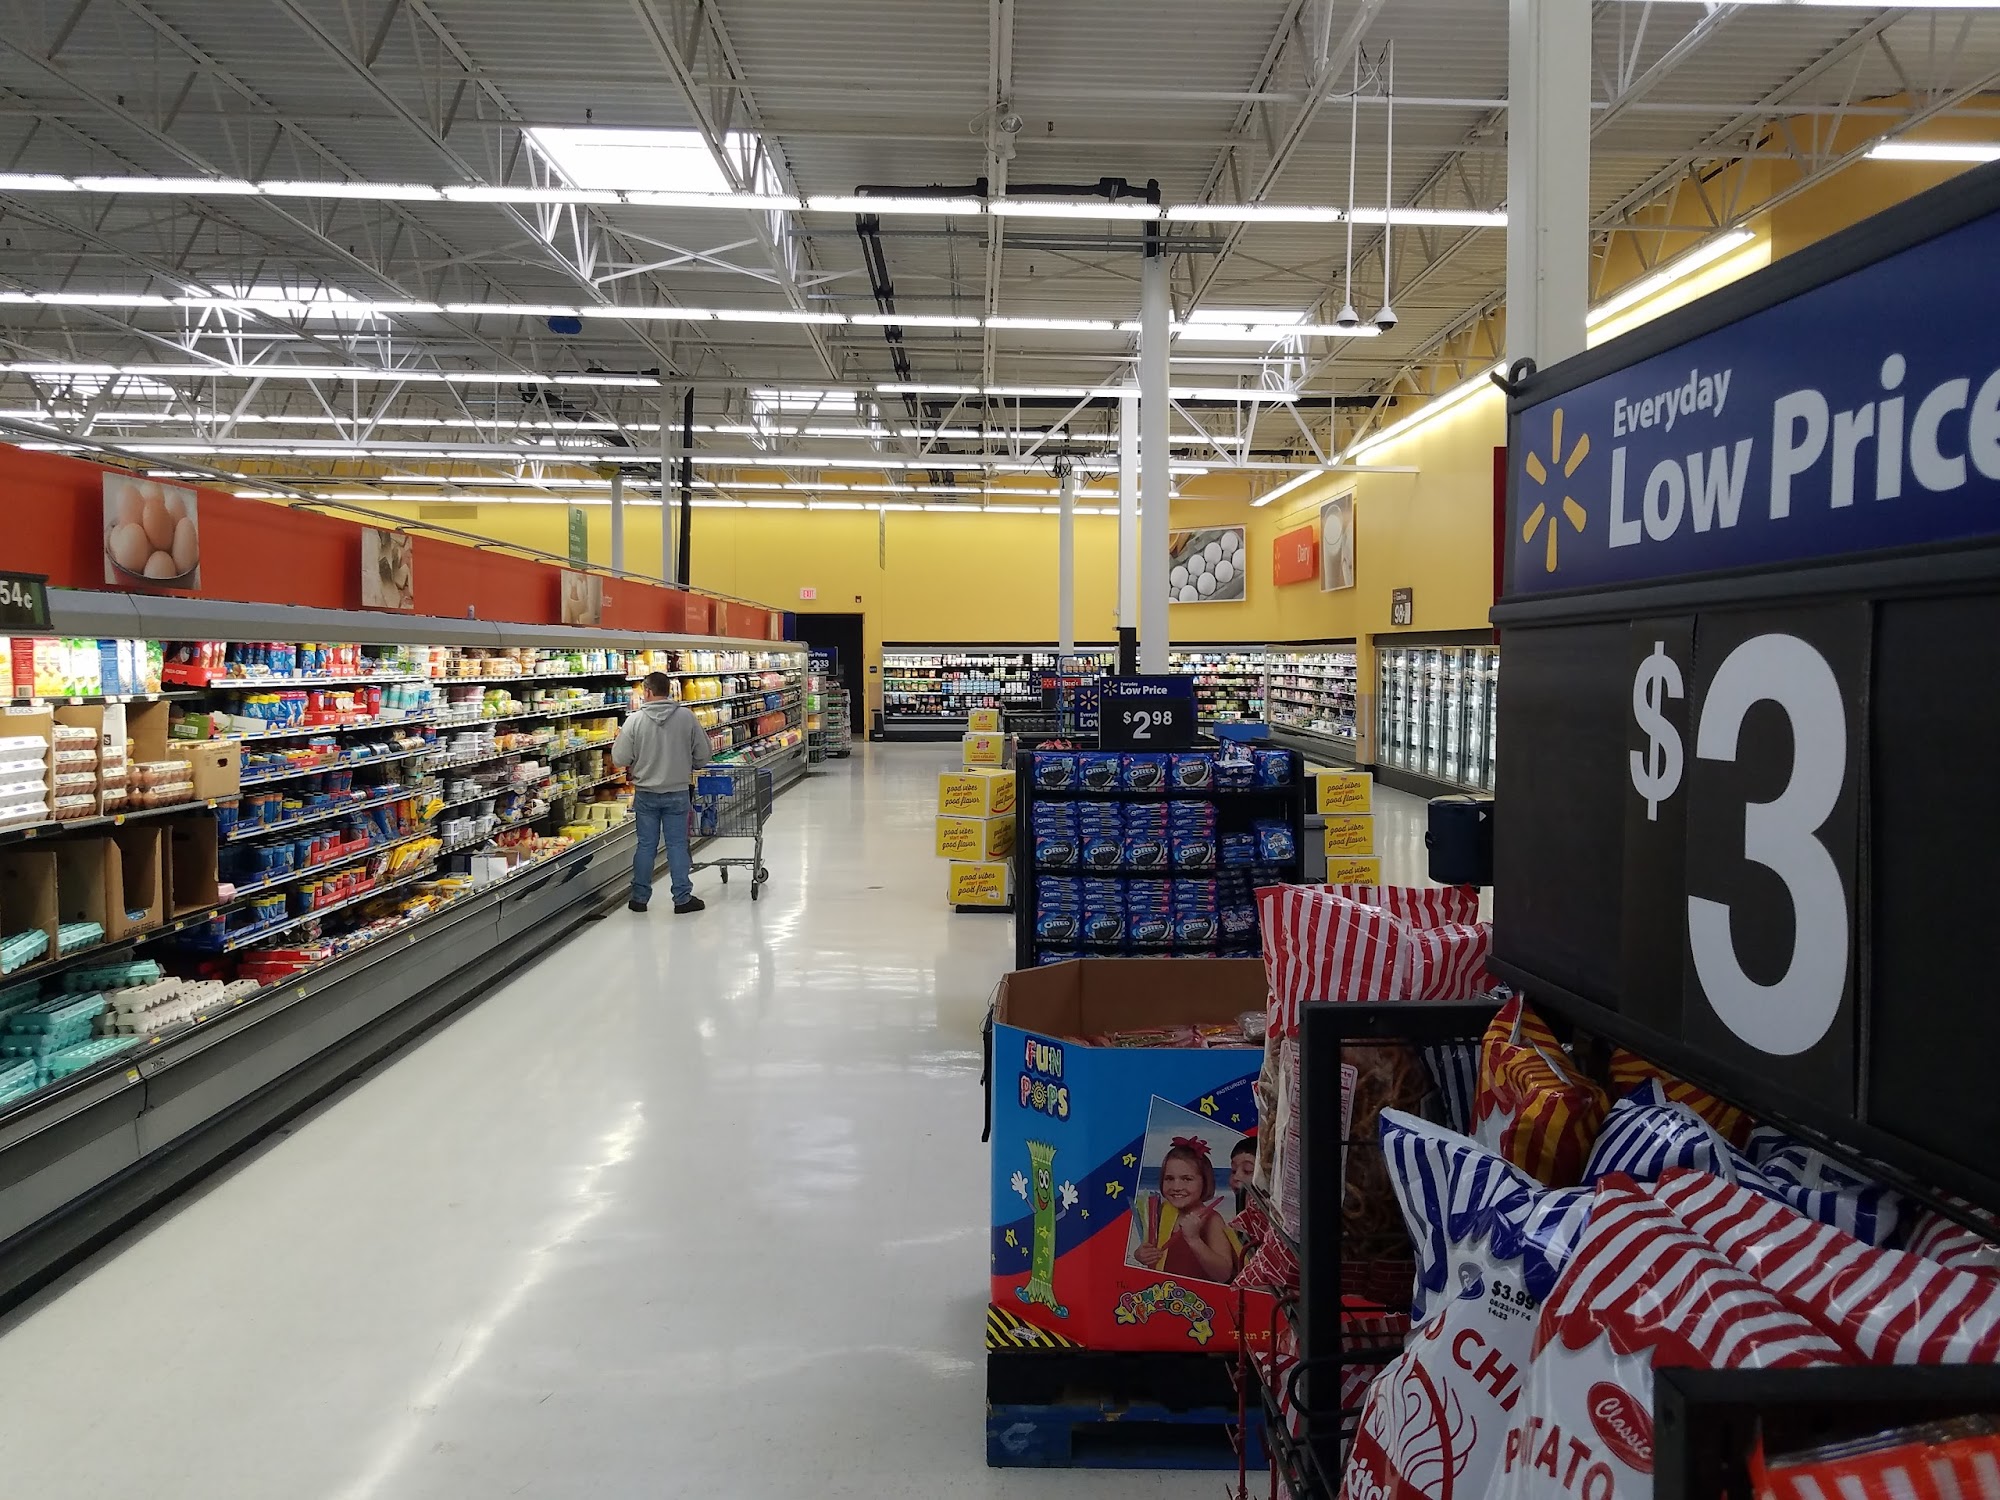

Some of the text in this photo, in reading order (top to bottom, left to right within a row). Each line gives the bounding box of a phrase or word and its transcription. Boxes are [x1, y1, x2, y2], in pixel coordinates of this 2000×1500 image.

[1613, 368, 1732, 438] Everyday
[1609, 437, 1753, 549] Low
[1120, 684, 1168, 695] Low Price
[1041, 765, 1063, 774] OREO
[1085, 767, 1107, 776] OREO
[1129, 768, 1156, 778] OREO
[1179, 764, 1204, 774] OREO
[1043, 847, 1069, 855] OREO
[1090, 846, 1116, 855] OREO
[1132, 846, 1158, 857] OREO
[1181, 846, 1207, 857] OREO
[1044, 920, 1070, 929] OREO
[1091, 920, 1117, 930] OREO
[1139, 923, 1165, 934] OREO
[1182, 921, 1208, 931] OREO
[1026, 1040, 1062, 1078] FUN
[1021, 1075, 1068, 1117] POPS
[1491, 1280, 1536, 1311] $3.99
[1595, 1397, 1652, 1459] Classic
